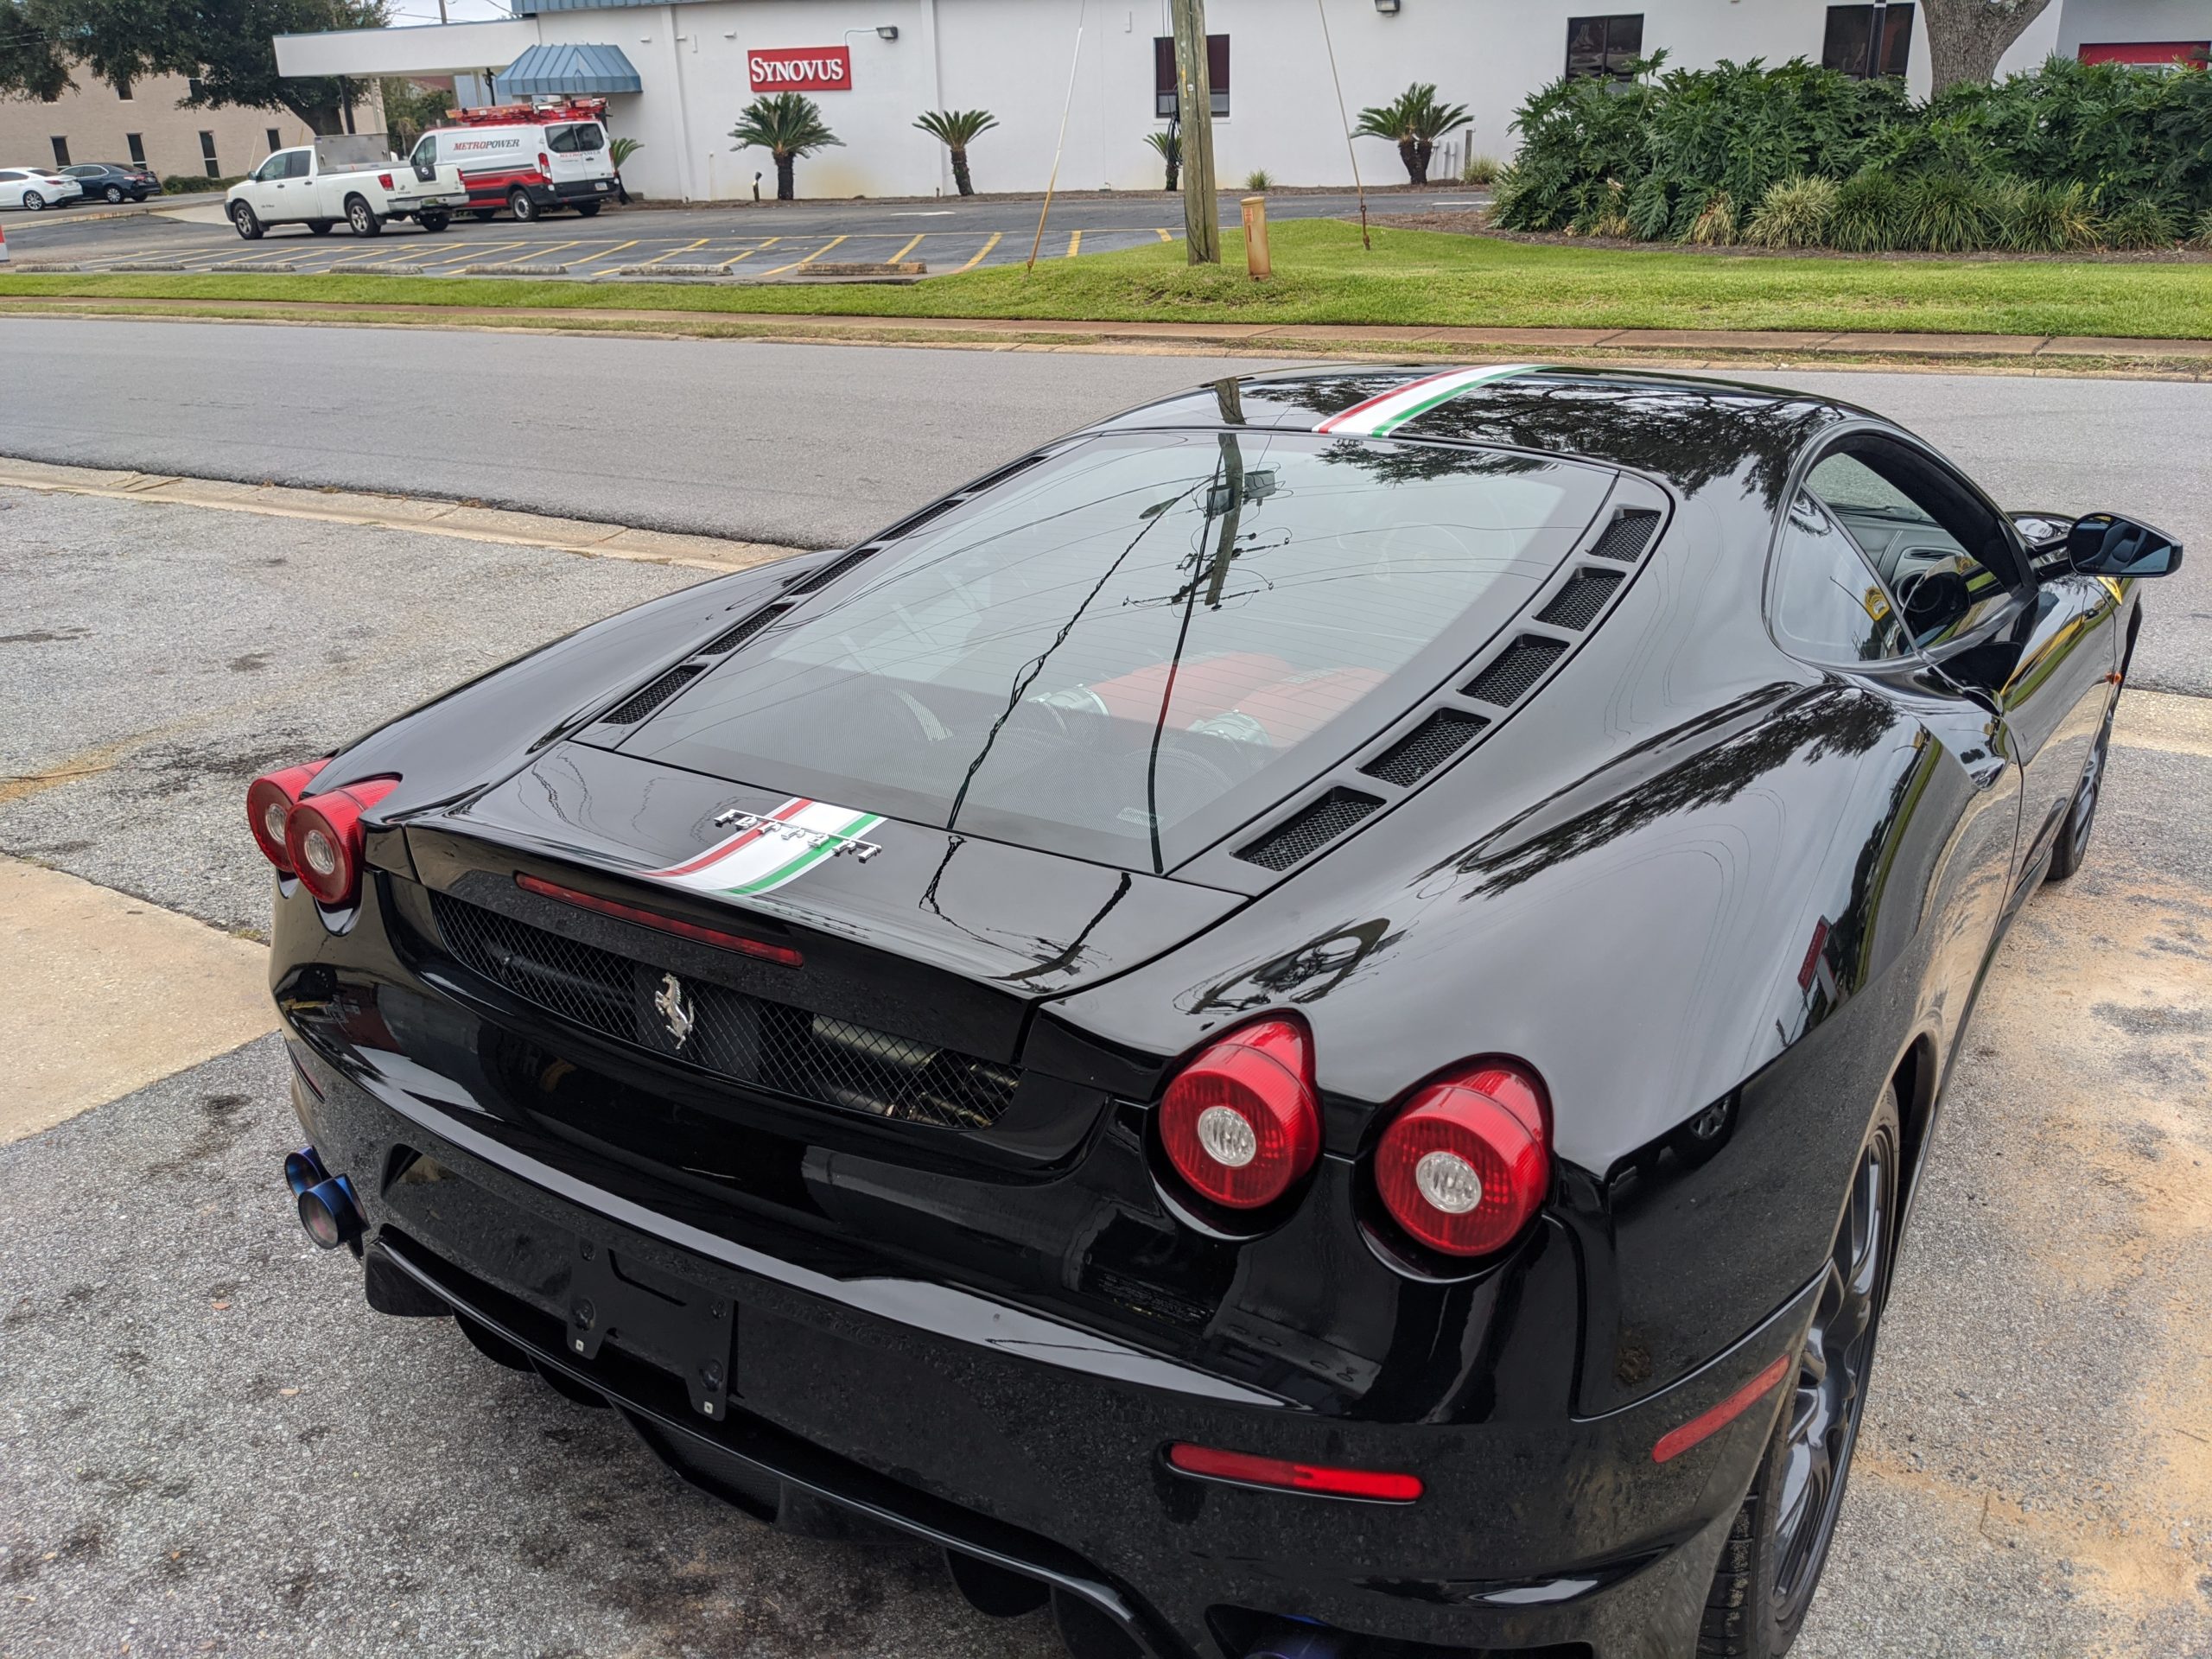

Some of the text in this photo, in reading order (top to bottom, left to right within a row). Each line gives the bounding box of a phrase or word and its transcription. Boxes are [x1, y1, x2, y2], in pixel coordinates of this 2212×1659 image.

[751, 57, 844, 82] SYNOVUS
[454, 139, 519, 150] METROPOWER
[714, 809, 882, 864] Ferrari
